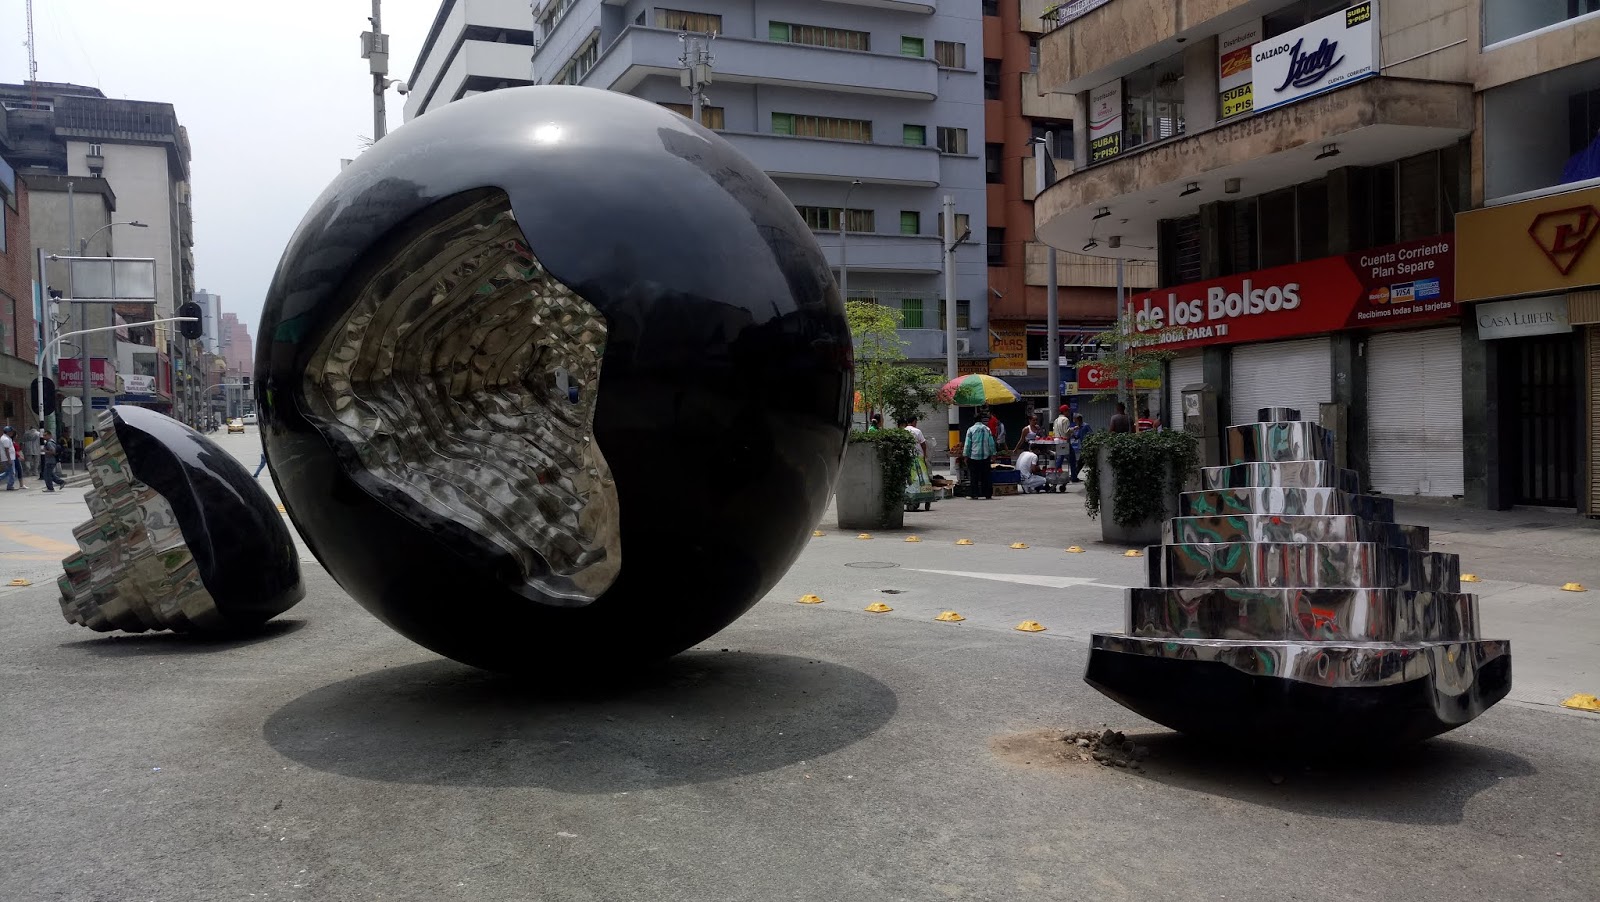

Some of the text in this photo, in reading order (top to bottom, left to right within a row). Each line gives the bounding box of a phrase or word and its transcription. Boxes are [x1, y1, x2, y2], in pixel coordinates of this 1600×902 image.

[1347, 7, 1365, 18] SUBA
[1224, 31, 1257, 49] Distribuidor
[1255, 44, 1290, 62] CALZADO
[1274, 38, 1345, 93] Italy
[1328, 66, 1371, 85] CUENTA CORRIENTE
[1224, 86, 1251, 102] SUBA
[1093, 136, 1113, 149] SUBA
[1101, 146, 1119, 158] PISO
[1360, 242, 1449, 268] Cuenta Corriente
[1372, 259, 1435, 279] Plan Separe
[1396, 288, 1411, 297] VISA
[1136, 298, 1165, 332] de
[1168, 293, 1204, 327] los
[1207, 279, 1301, 320] Bolsos
[1357, 301, 1452, 320] Recibimos todas las tarjetas
[1478, 314, 1511, 329] CASA
[1160, 331, 1184, 344] MODA
[1186, 325, 1214, 340] PARA
[1215, 323, 1228, 336] TI
[993, 339, 1024, 352] PILAS
[60, 371, 80, 380] Credi
